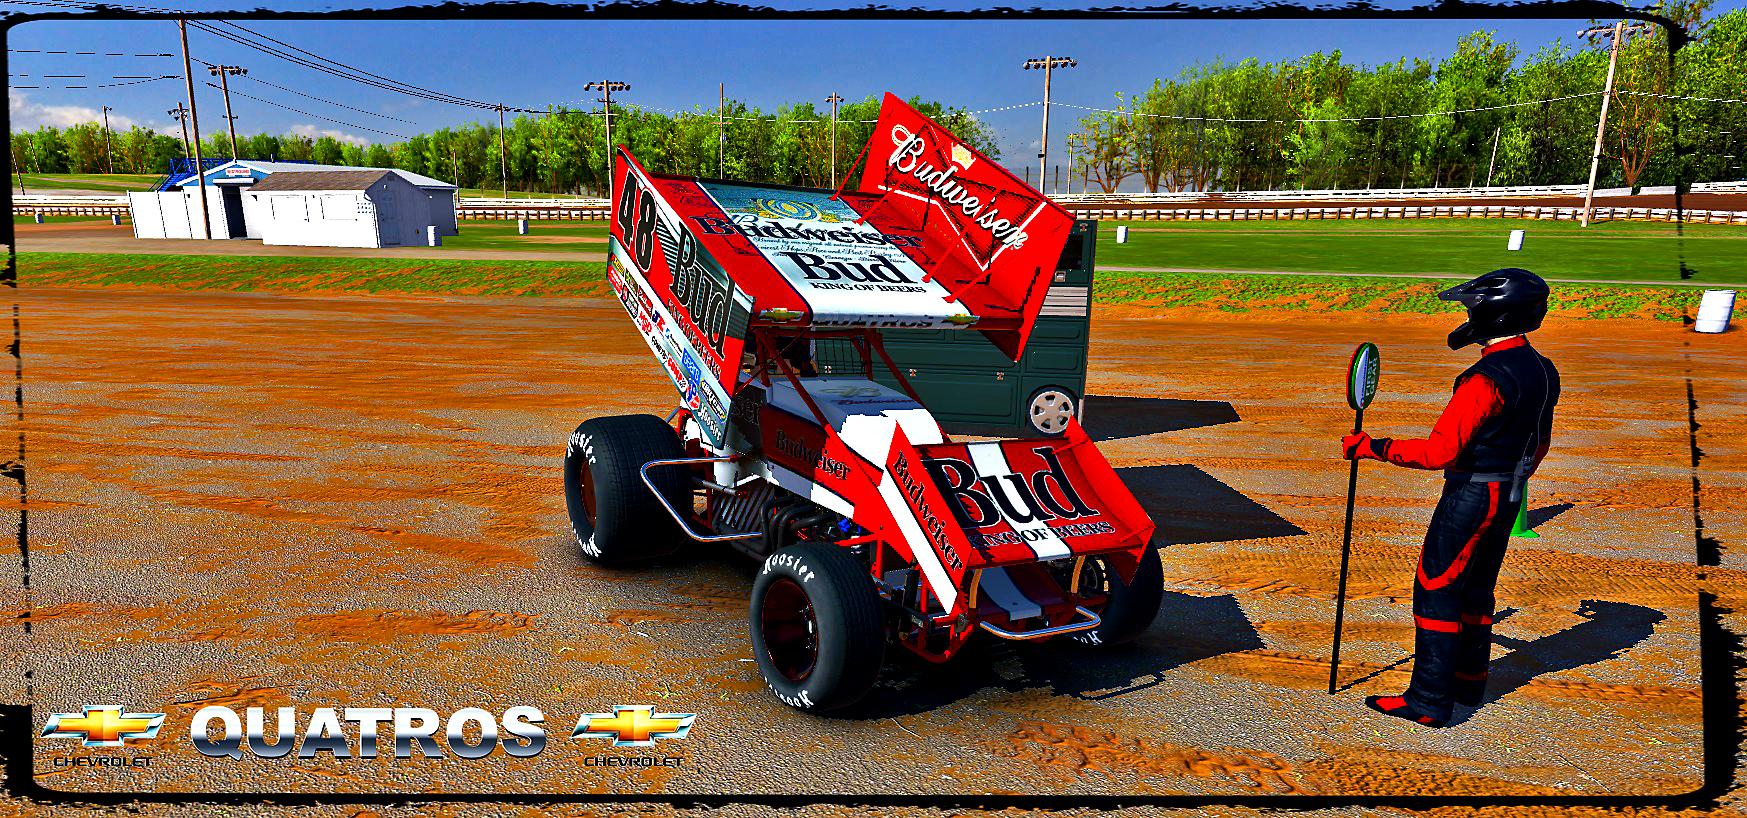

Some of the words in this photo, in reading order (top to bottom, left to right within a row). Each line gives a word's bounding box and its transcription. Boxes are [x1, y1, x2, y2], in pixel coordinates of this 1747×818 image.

[889, 124, 1028, 249] Budweiser
[618, 168, 657, 272] 48
[687, 215, 925, 249] Budweiser
[668, 220, 736, 362] Bud
[780, 251, 917, 284] Bud
[810, 282, 854, 291] KING
[854, 283, 876, 291] OF
[875, 284, 927, 293] BEERS
[775, 429, 851, 480] Budweiser
[893, 451, 964, 571] Budweiser
[920, 446, 1101, 528] Bud
[1021, 527, 1050, 542] OF
[1049, 521, 1116, 539] BEERS
[763, 554, 815, 582] Hoosier
